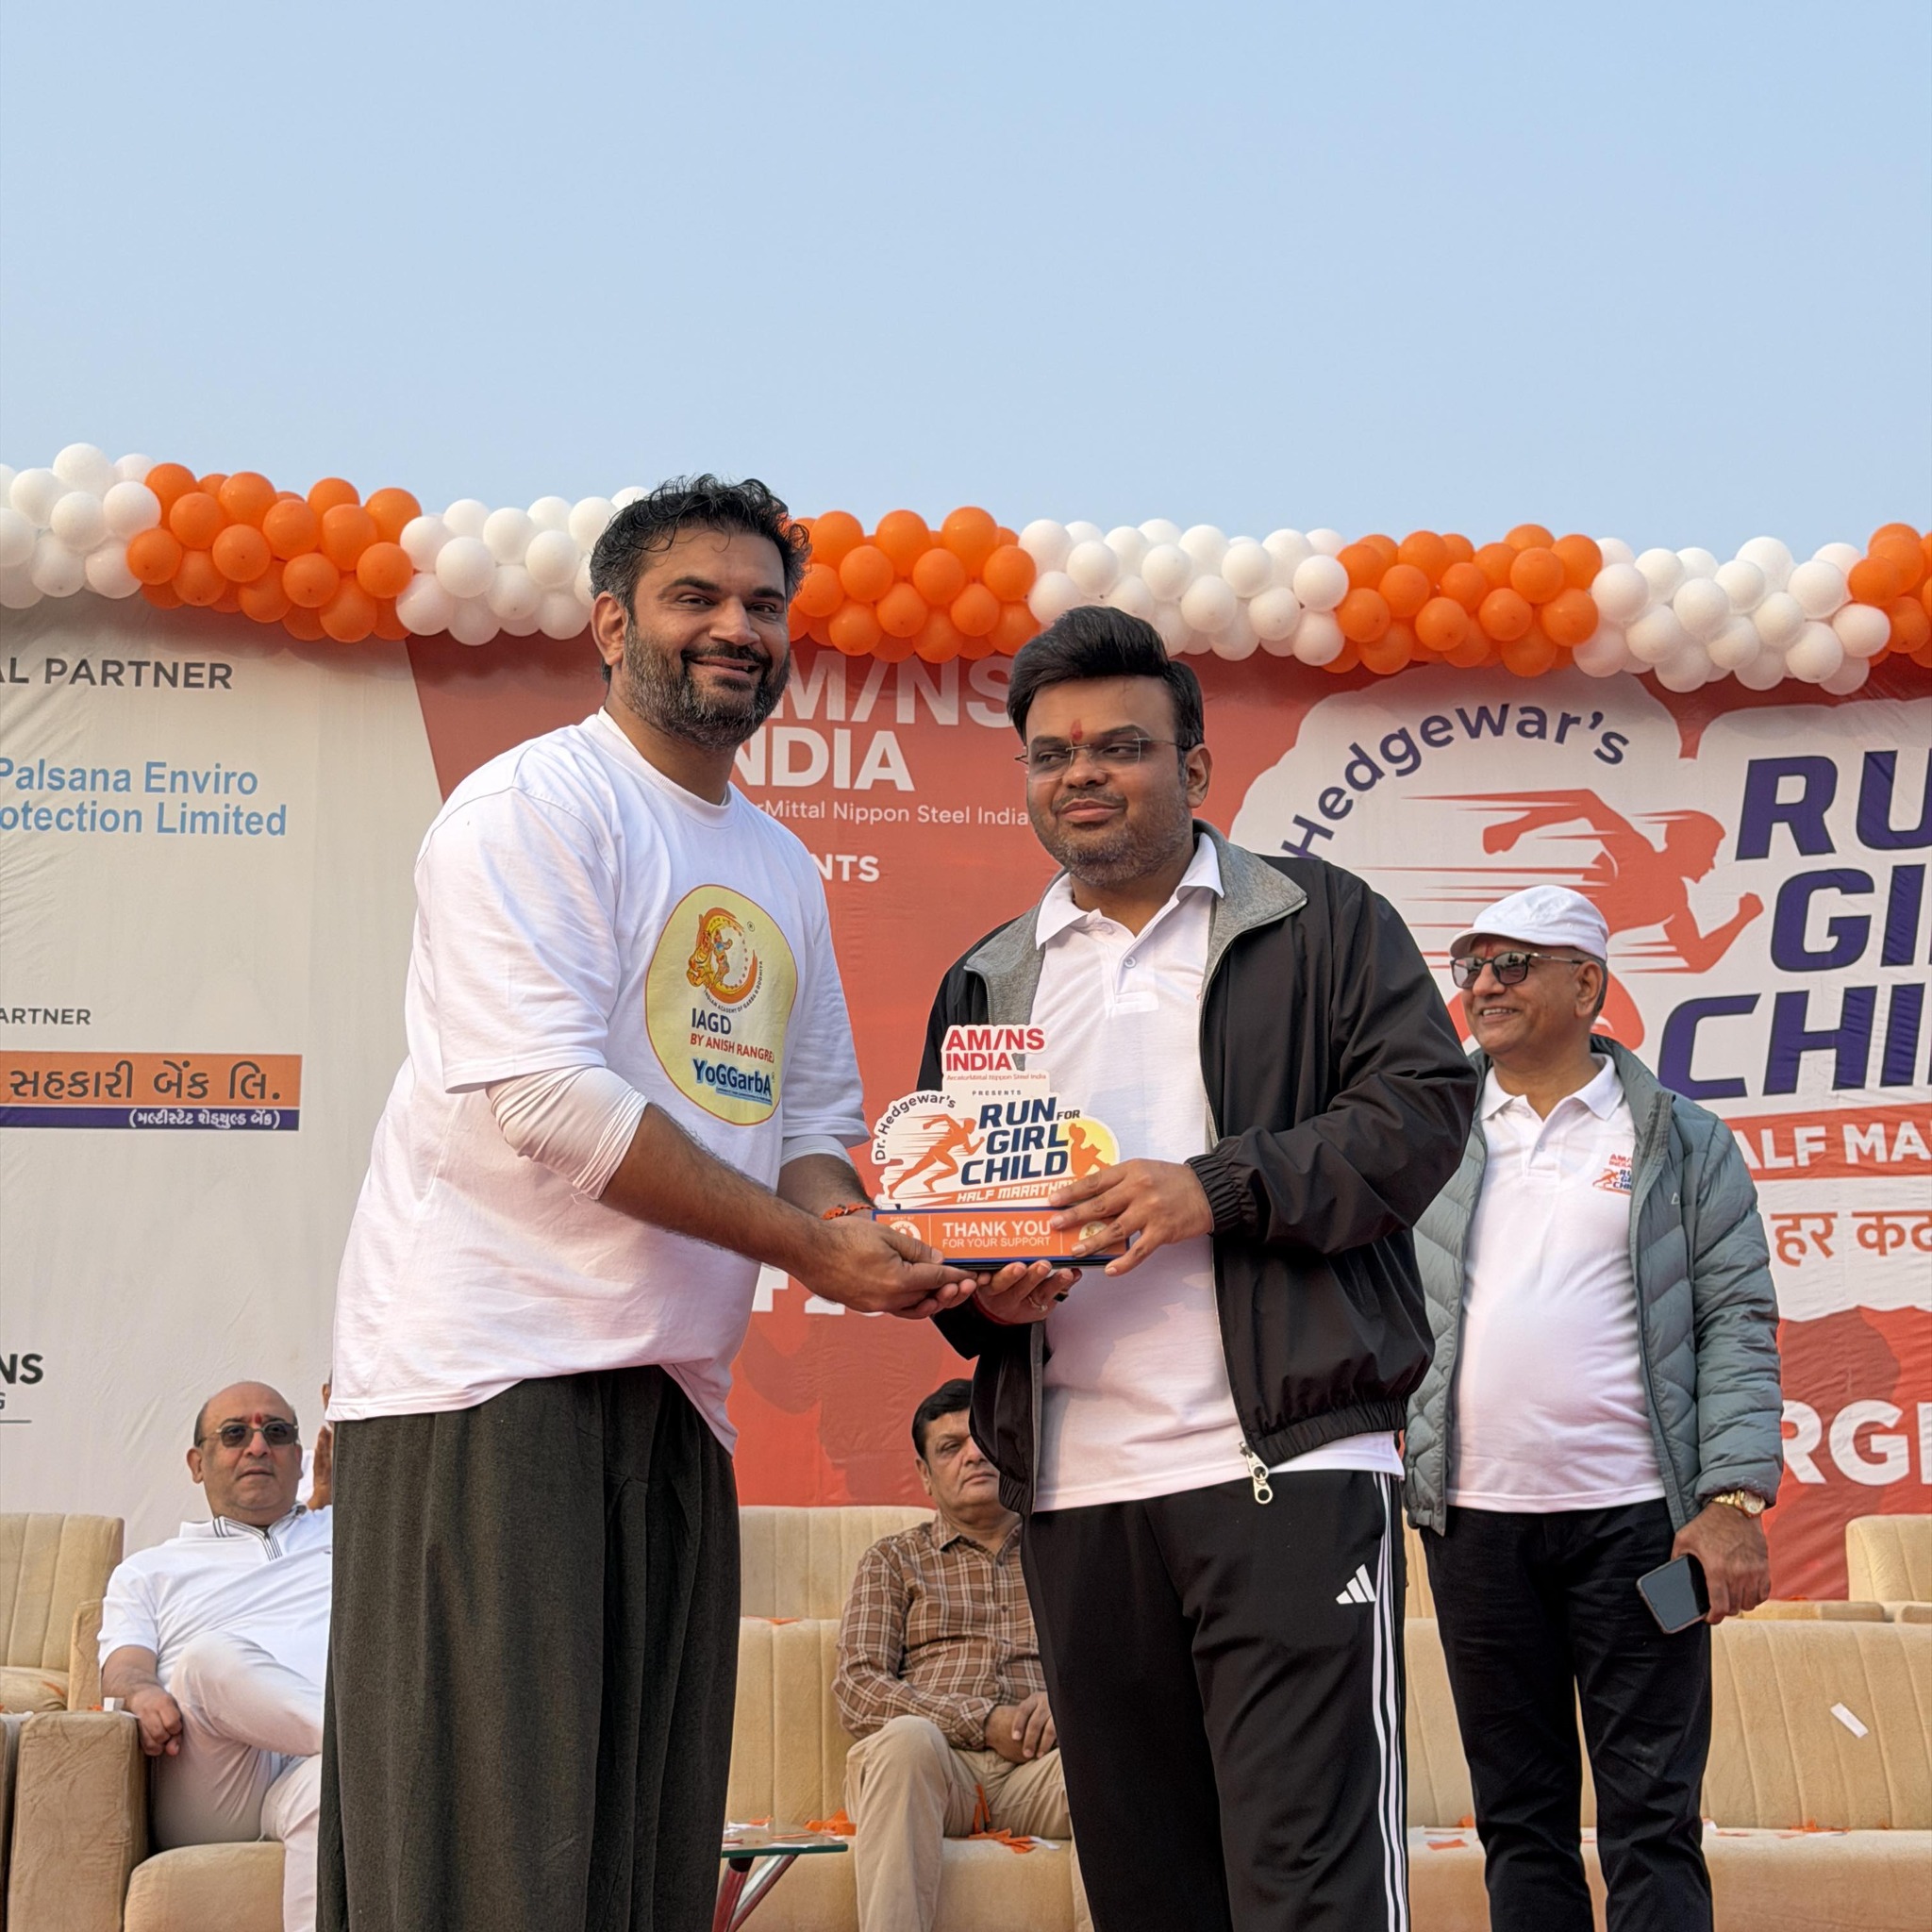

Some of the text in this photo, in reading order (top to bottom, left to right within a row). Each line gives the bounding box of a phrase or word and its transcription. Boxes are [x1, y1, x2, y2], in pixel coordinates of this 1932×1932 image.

[0, 658, 234, 690] L PARTNER
[0, 758, 258, 795] Palsana Enviro
[0, 800, 287, 837] otection Limited
[833, 801, 909, 825] Nippon
[917, 805, 970, 824] Steel
[977, 806, 1029, 826] India
[1735, 748, 1932, 861] RU
[1770, 863, 1932, 973] GI
[0, 1008, 91, 1025] ARTNER
[691, 1008, 731, 1035] IAGD
[691, 1033, 705, 1046] BY
[706, 1036, 735, 1054] ANISH
[945, 1028, 1045, 1051] AM/NS
[1657, 983, 1932, 1101] CHI
[945, 1053, 1012, 1072] INDIA
[9, 1059, 281, 1101] સહકારી બેંક લિ.
[978, 1096, 1081, 1130] RUN FOR
[874, 1140, 887, 1160] Dr.
[986, 1124, 1069, 1156] GIRL
[960, 1150, 1069, 1186] CHILD
[957, 1190, 994, 1204] HALF
[942, 1236, 1051, 1249] FOR YOUR SUPPORT
[943, 1221, 1052, 1239] THANK YOU
[1770, 1212, 1839, 1267] हर
